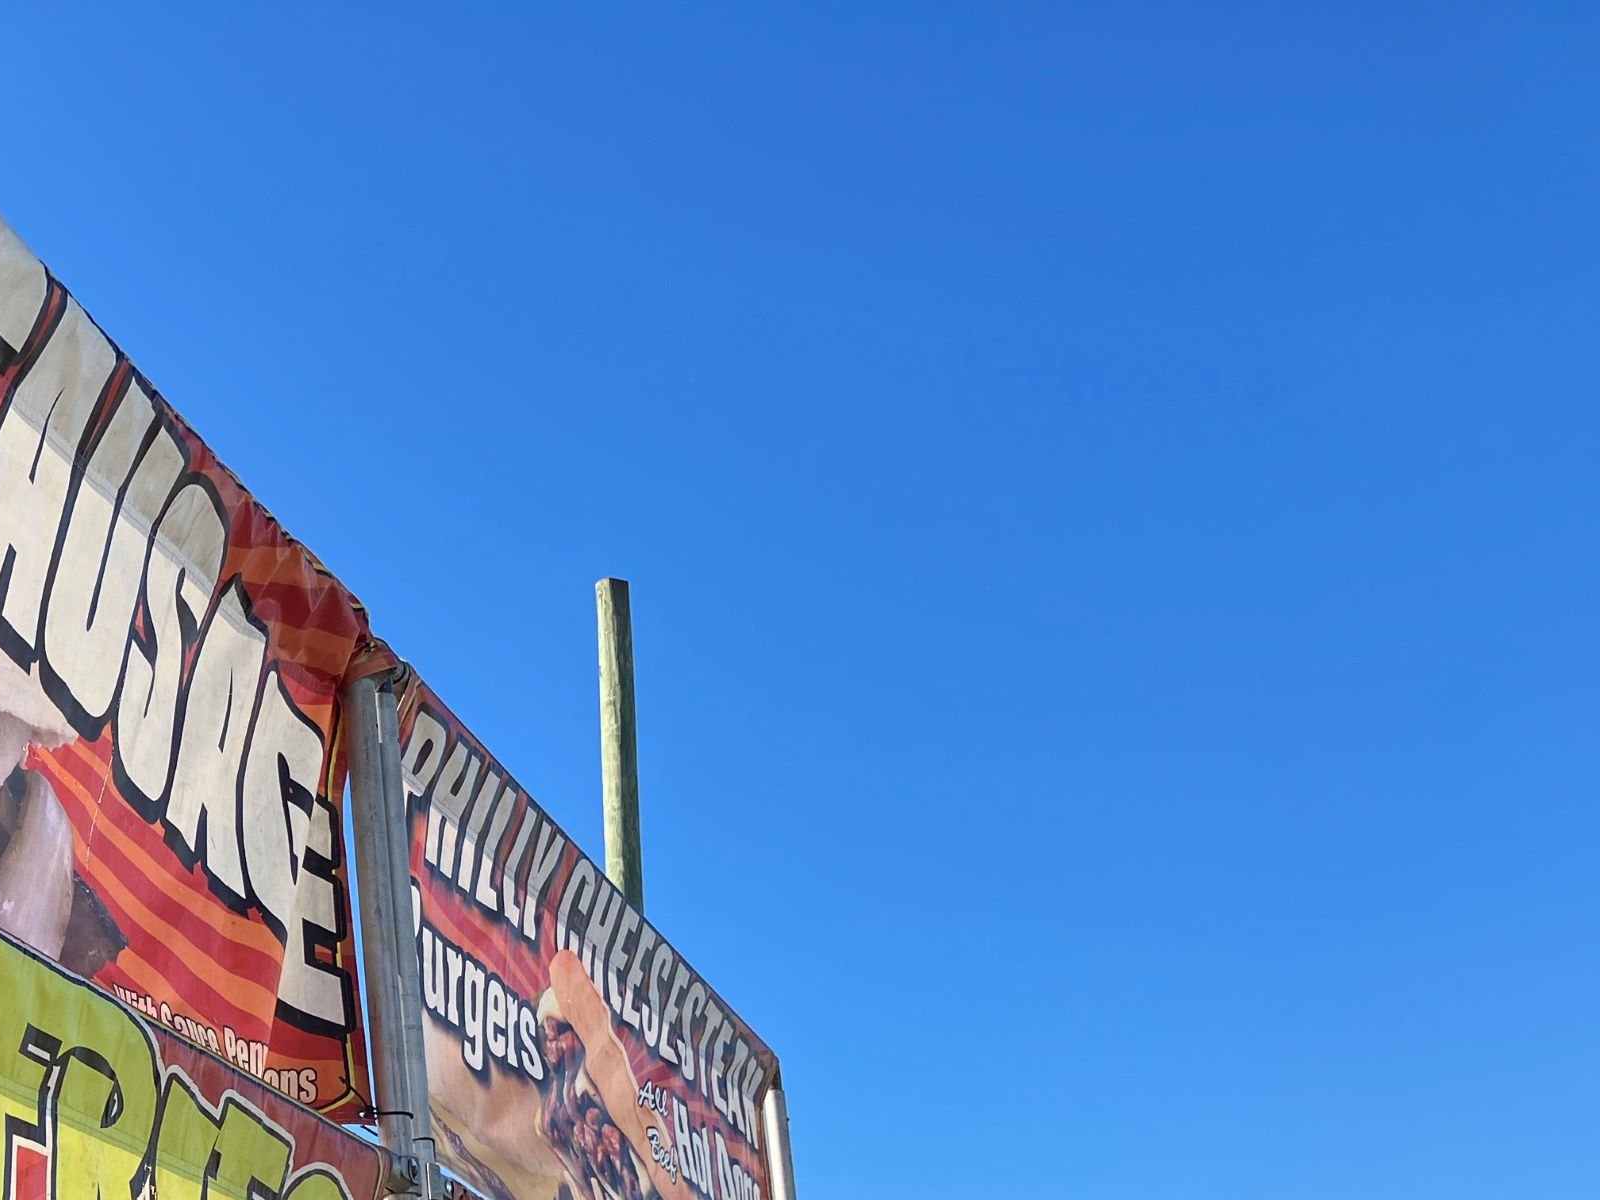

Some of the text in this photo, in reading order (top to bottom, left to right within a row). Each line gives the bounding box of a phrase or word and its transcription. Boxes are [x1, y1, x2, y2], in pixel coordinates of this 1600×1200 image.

[401, 711, 765, 1149] PHILLY CHEESESTEAK
[638, 1080, 668, 1117] All
[647, 1125, 678, 1184] Beef
